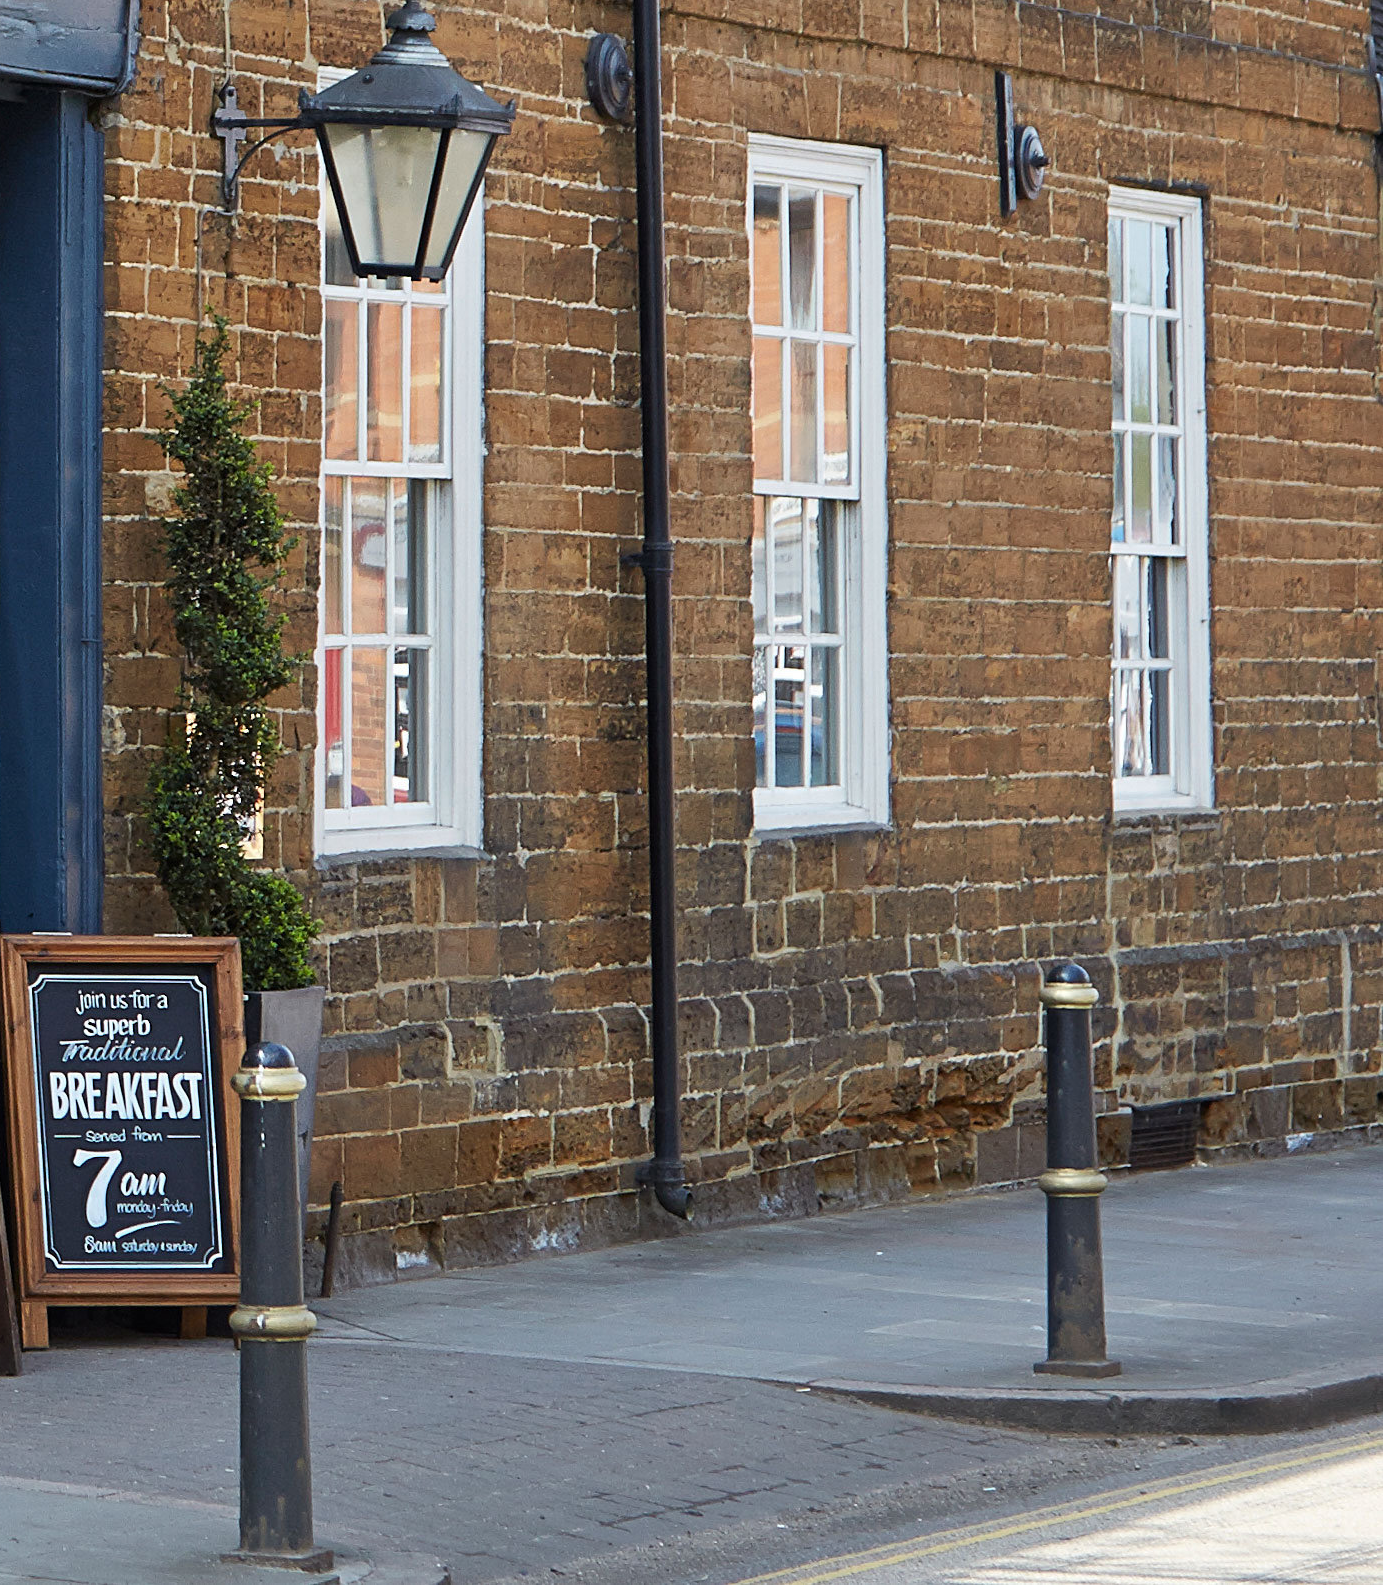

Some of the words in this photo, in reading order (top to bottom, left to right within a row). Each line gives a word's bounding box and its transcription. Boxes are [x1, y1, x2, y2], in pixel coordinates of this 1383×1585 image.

[75, 989, 106, 1016] join
[110, 993, 128, 1010] us
[129, 989, 155, 1009] for
[156, 994, 169, 1010] a
[83, 1013, 151, 1040] superb
[59, 1035, 186, 1063] Traditional
[49, 1071, 203, 1120] BREAKFAST
[131, 1125, 163, 1142] from
[72, 1148, 123, 1228] 7
[120, 1171, 167, 1197] am
[84, 1235, 118, 1254] 8am
